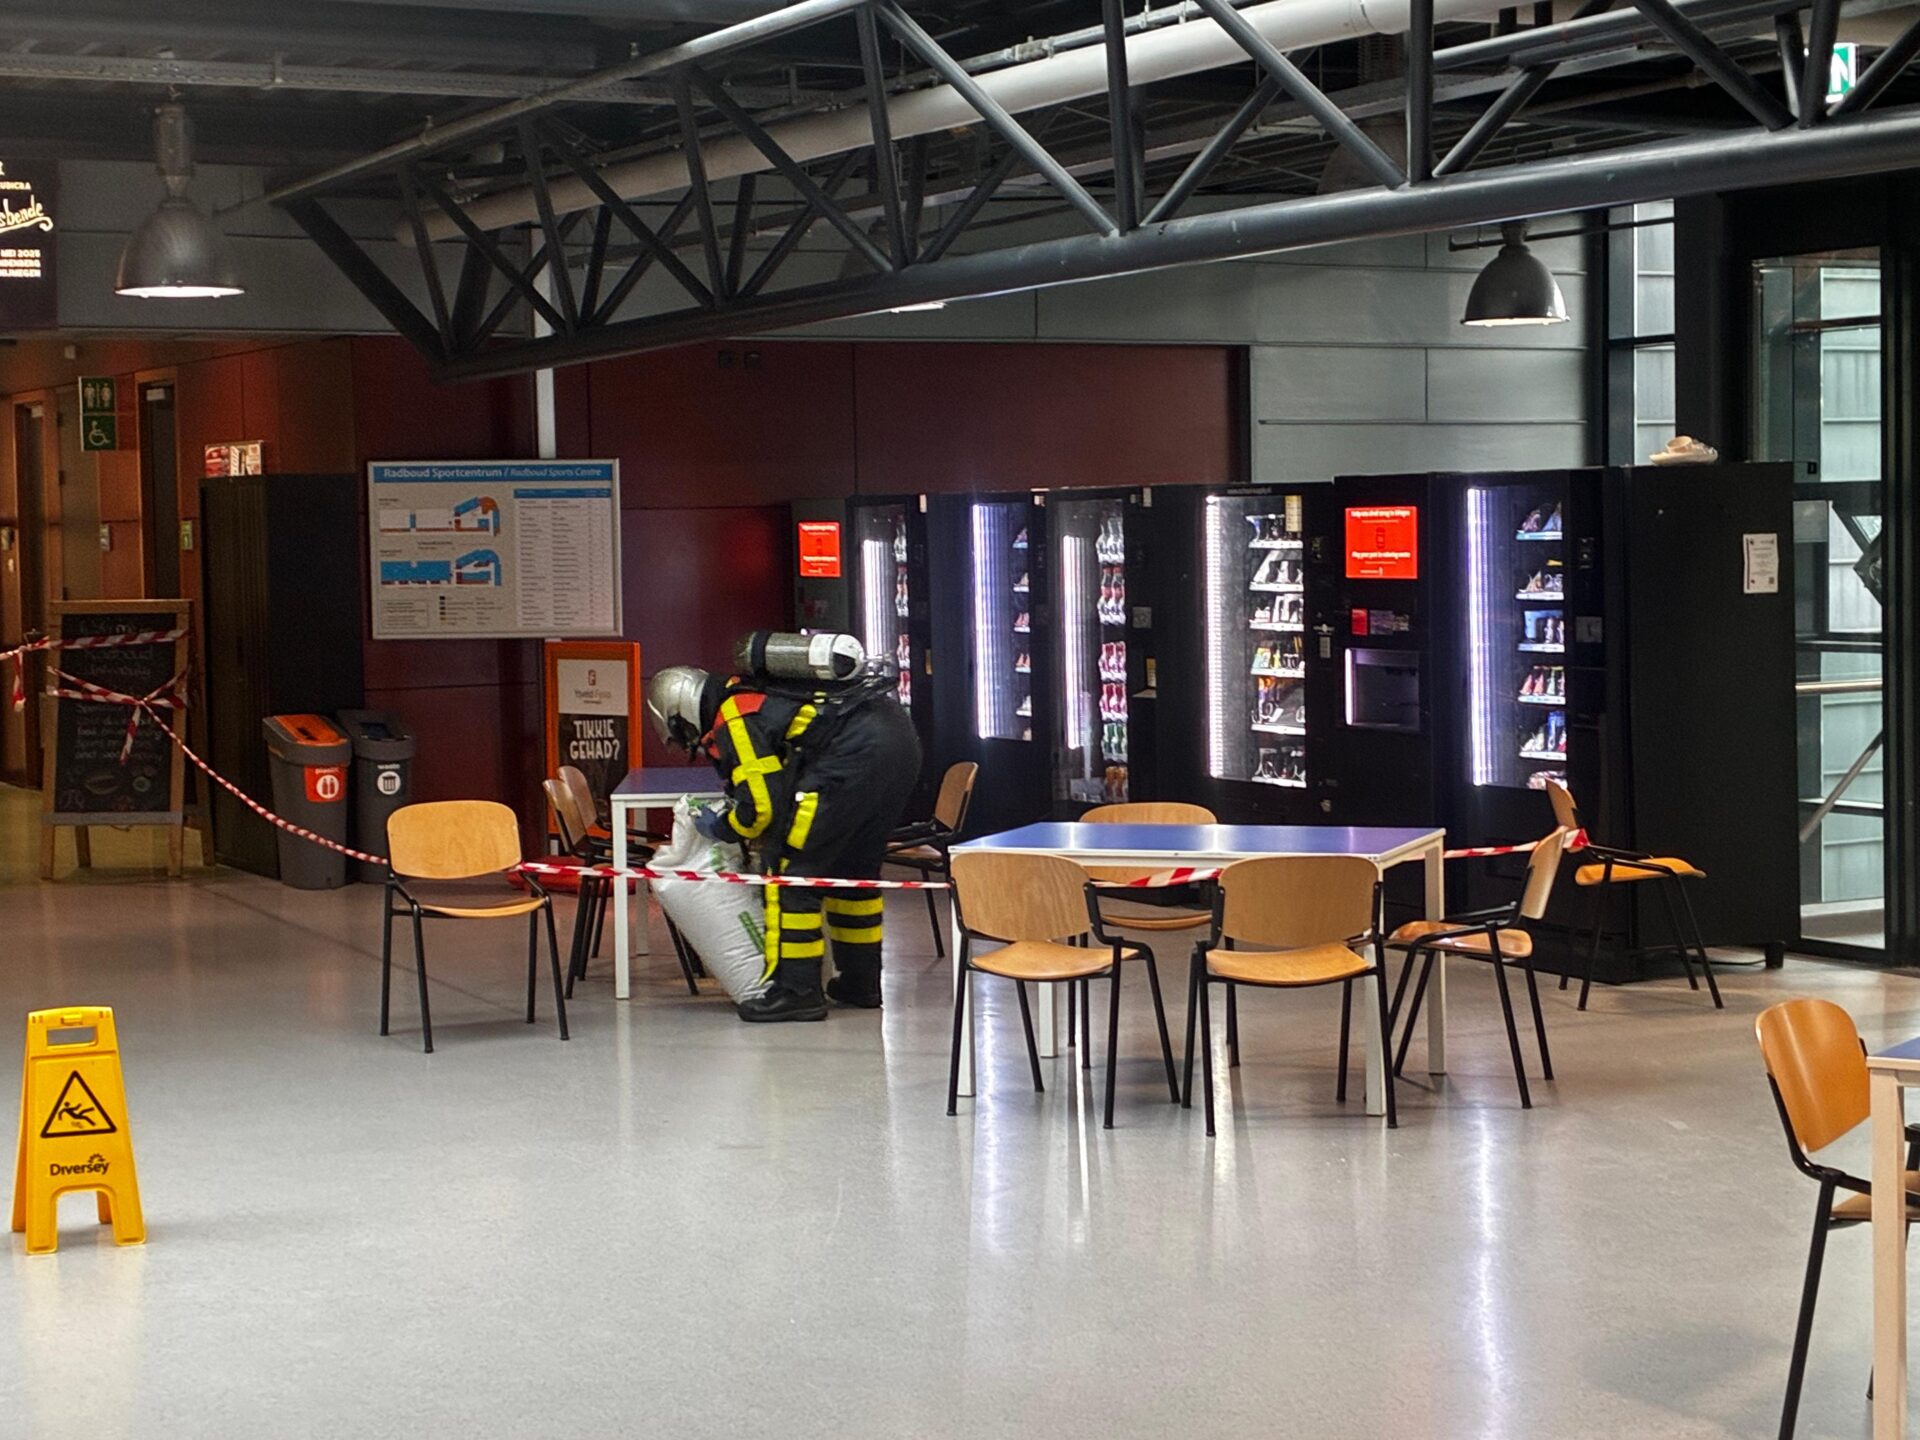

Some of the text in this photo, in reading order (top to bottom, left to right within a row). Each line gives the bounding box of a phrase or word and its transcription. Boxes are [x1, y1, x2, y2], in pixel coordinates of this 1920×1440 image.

[384, 468, 430, 477] Radboud
[432, 468, 502, 479] Sportcentrum
[573, 720, 615, 738] TIKKIE
[570, 740, 620, 760] GEHAD?
[50, 1163, 110, 1176] Diversey
